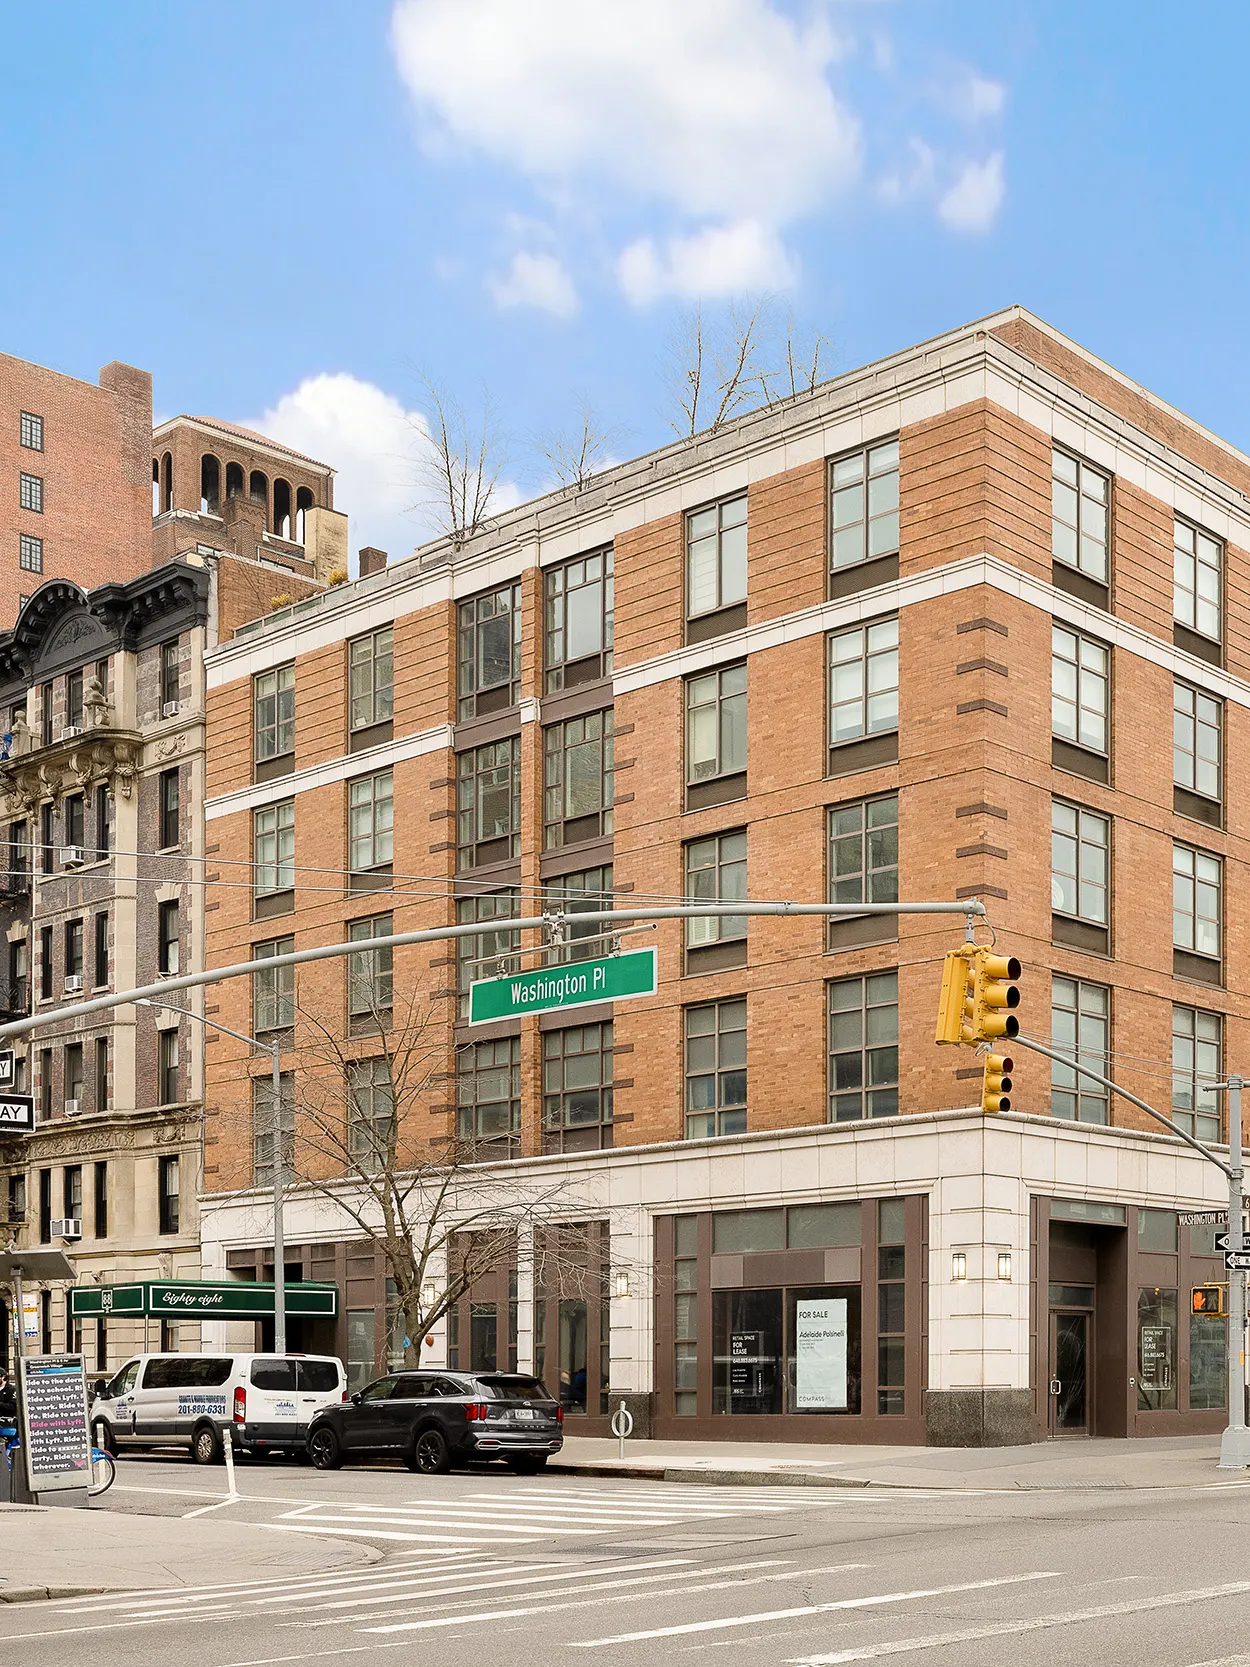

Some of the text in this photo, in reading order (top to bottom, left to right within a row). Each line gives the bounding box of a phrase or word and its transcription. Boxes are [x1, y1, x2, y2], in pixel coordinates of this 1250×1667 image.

[511, 966, 606, 1004] Washington Pl
[1245, 1198, 1249, 1208] 6
[1178, 1212, 1216, 1225] WASHINGTON
[1230, 1256, 1241, 1265] ONE
[162, 1292, 223, 1306] Eighty eight
[799, 1310, 828, 1319] FOR SALE
[47, 1385, 74, 1393] school.
[67, 1419, 84, 1427] Lyft.
[46, 1437, 63, 1445] Lyft.
